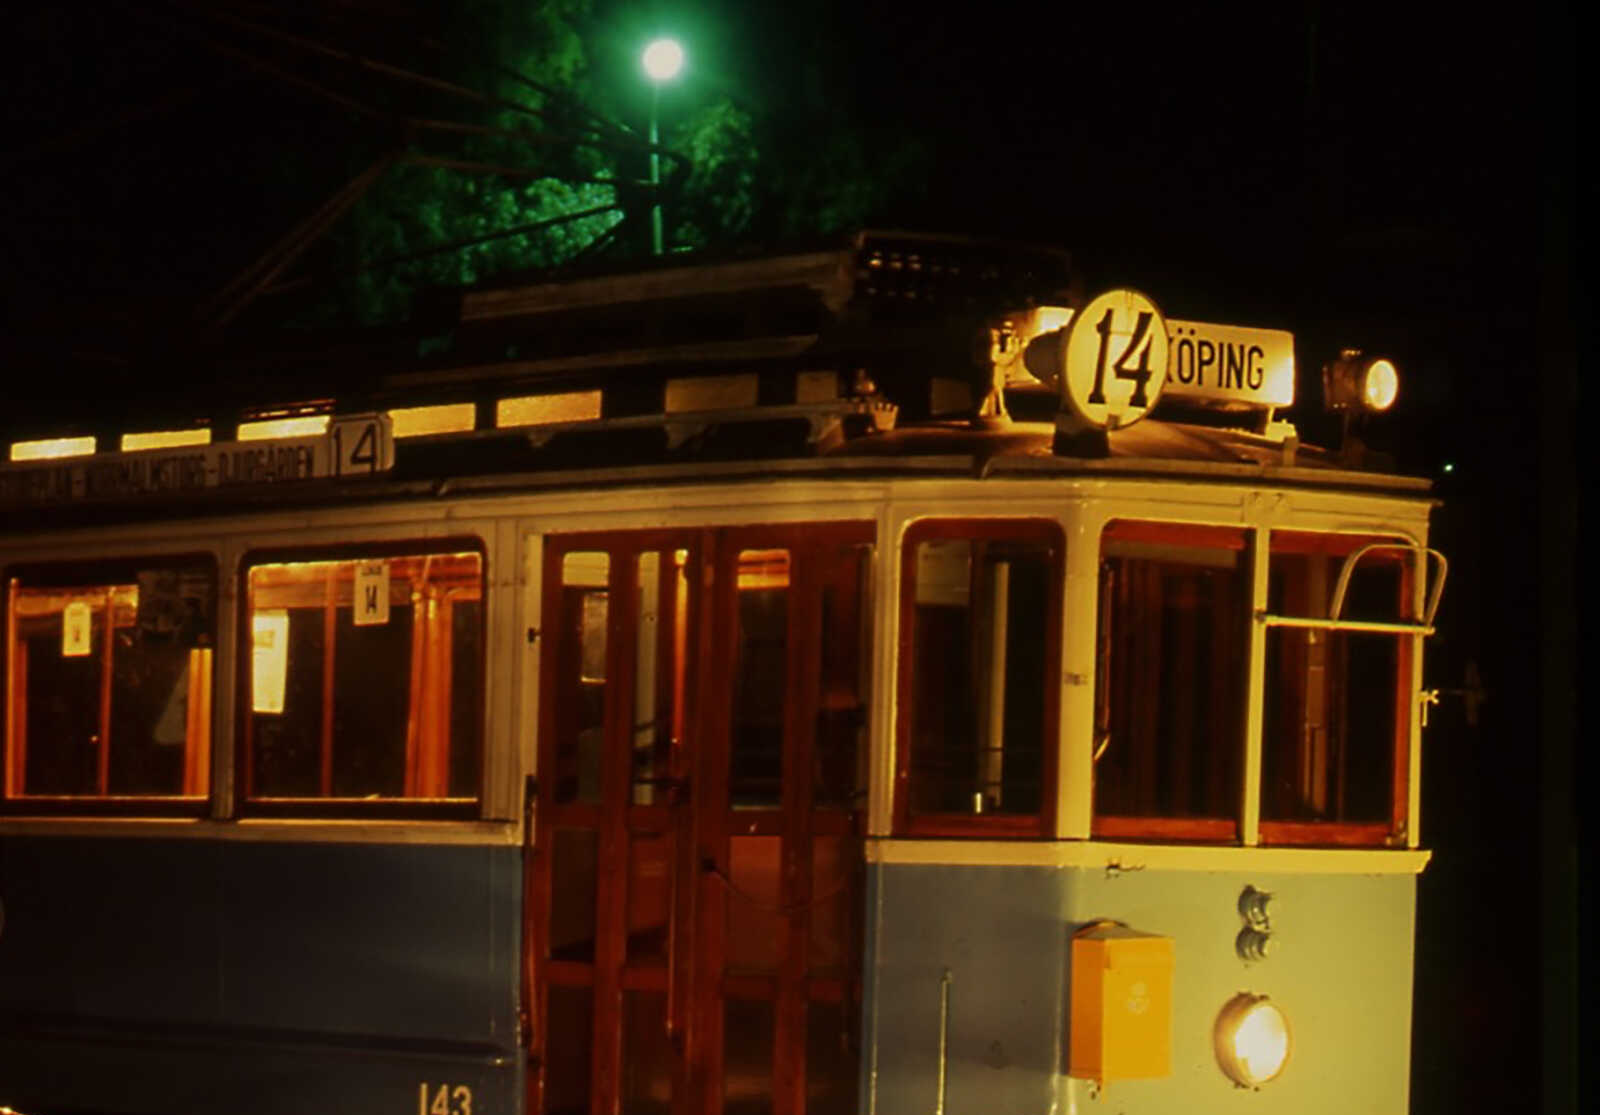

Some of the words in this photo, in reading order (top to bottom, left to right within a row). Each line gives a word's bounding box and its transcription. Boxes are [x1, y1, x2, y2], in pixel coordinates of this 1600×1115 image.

[1088, 308, 1153, 408] 14
[1167, 327, 1264, 391] ÖPING
[335, 423, 376, 477] 14
